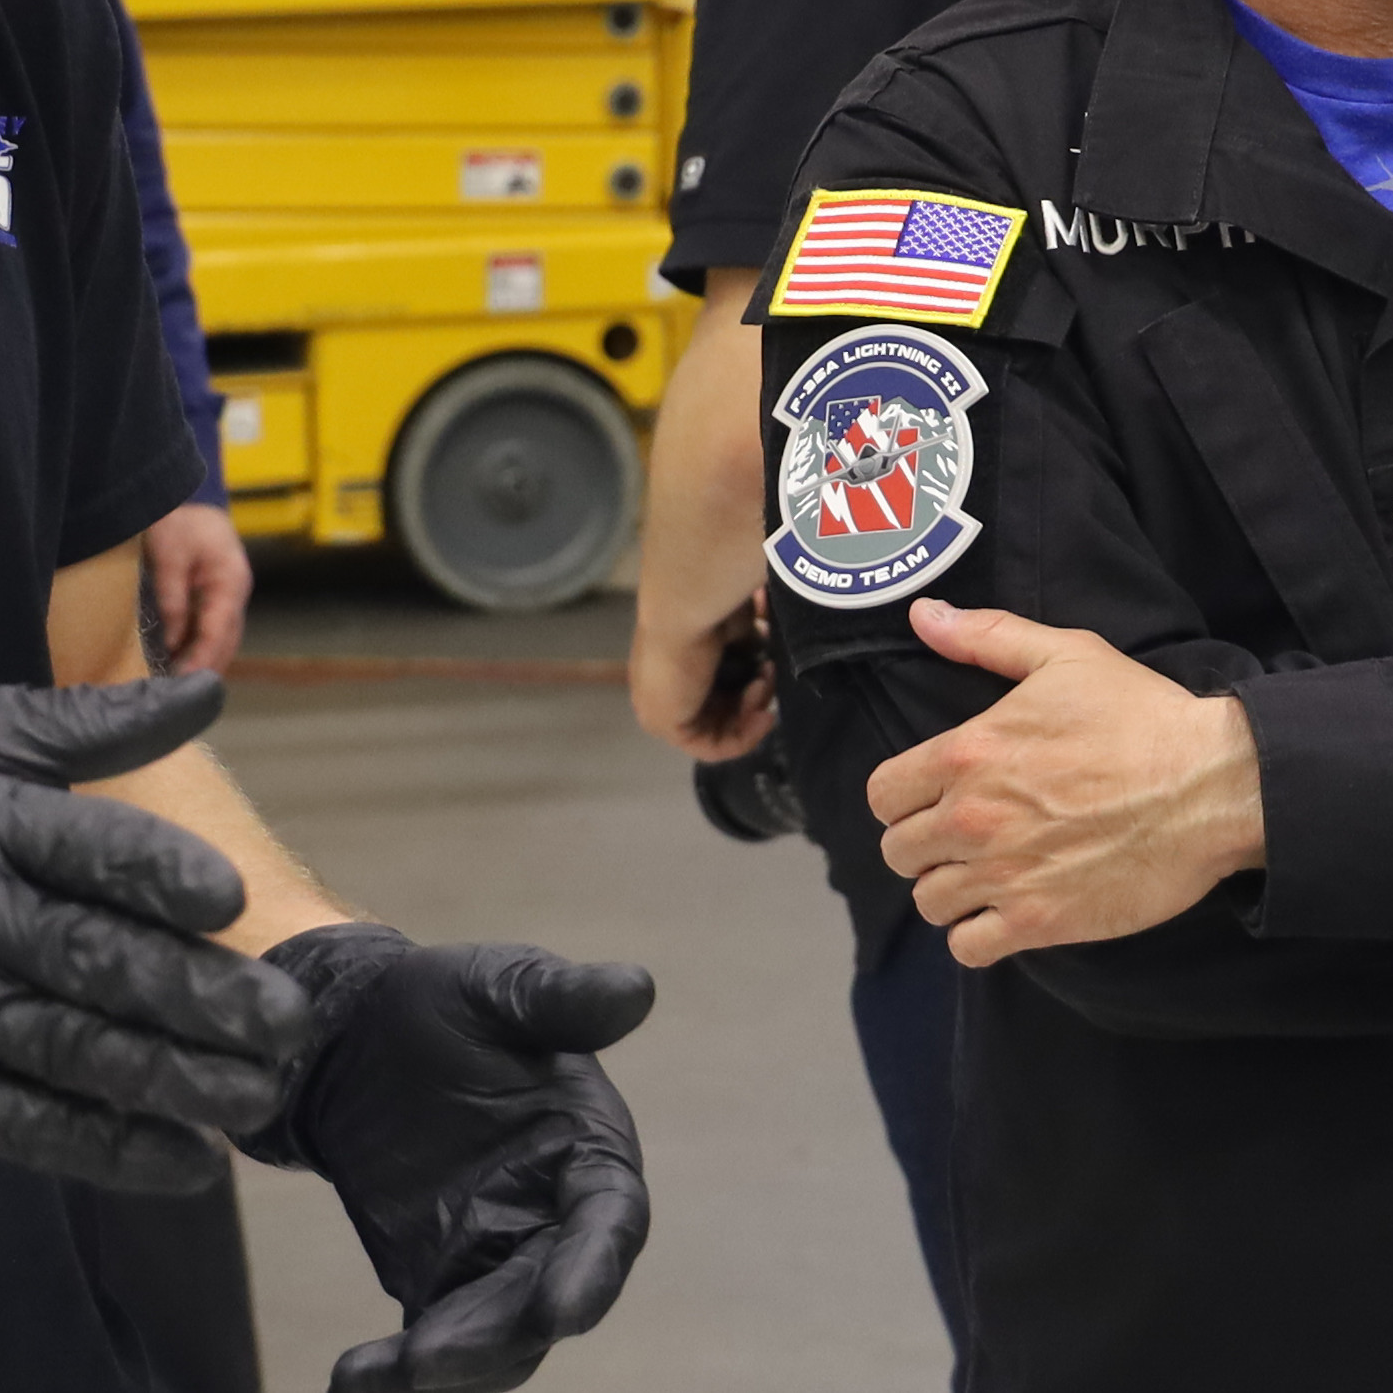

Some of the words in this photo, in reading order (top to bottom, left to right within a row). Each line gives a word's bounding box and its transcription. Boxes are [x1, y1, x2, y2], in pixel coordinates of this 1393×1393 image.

[790, 360, 840, 414] F-35A
[843, 342, 942, 375] LIGHTNING
[793, 556, 853, 589] DEMO
[859, 545, 930, 586] TEAM
